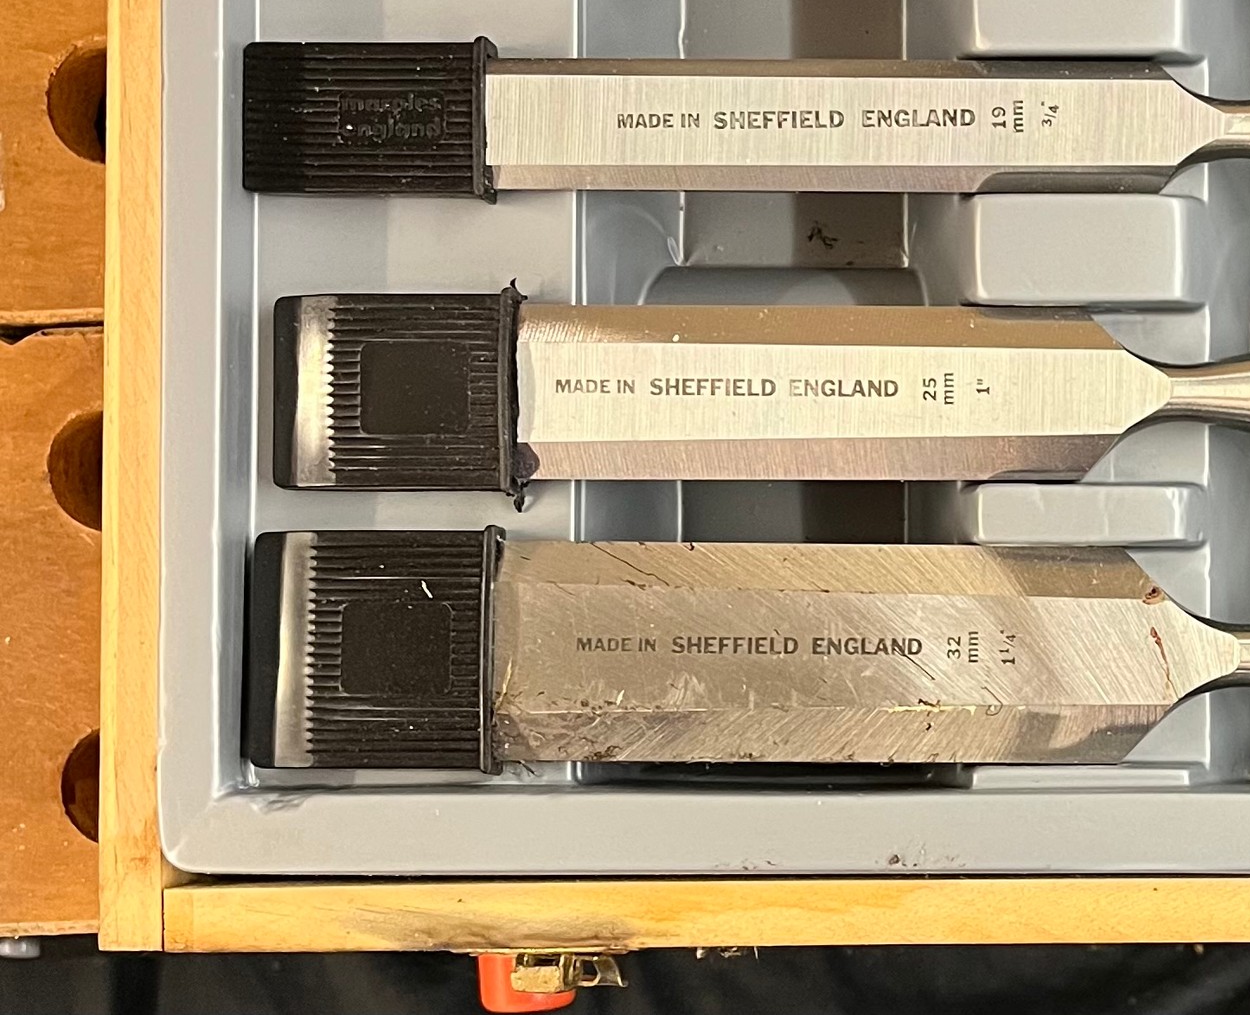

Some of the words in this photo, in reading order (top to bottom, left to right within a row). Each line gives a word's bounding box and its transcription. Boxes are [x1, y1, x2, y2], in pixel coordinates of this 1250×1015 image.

[617, 113, 674, 130] MADE
[681, 113, 701, 129] IN
[713, 109, 845, 130] SHEFFIELD
[861, 108, 976, 129] ENGLAND
[991, 105, 1007, 130] 19
[1012, 99, 1025, 134] mm
[555, 379, 611, 394] MADE
[617, 379, 636, 394] IN
[649, 377, 777, 397] SHEFFIELD
[788, 378, 900, 398] ENGLAND
[922, 377, 938, 402] 25
[943, 372, 955, 405] mm
[576, 636, 632, 652] MADE
[638, 637, 657, 652] IN
[671, 636, 799, 655] SHEFFIELD
[811, 636, 923, 656] ENGLAND
[946, 635, 962, 660] 32
[967, 630, 979, 664] mm
